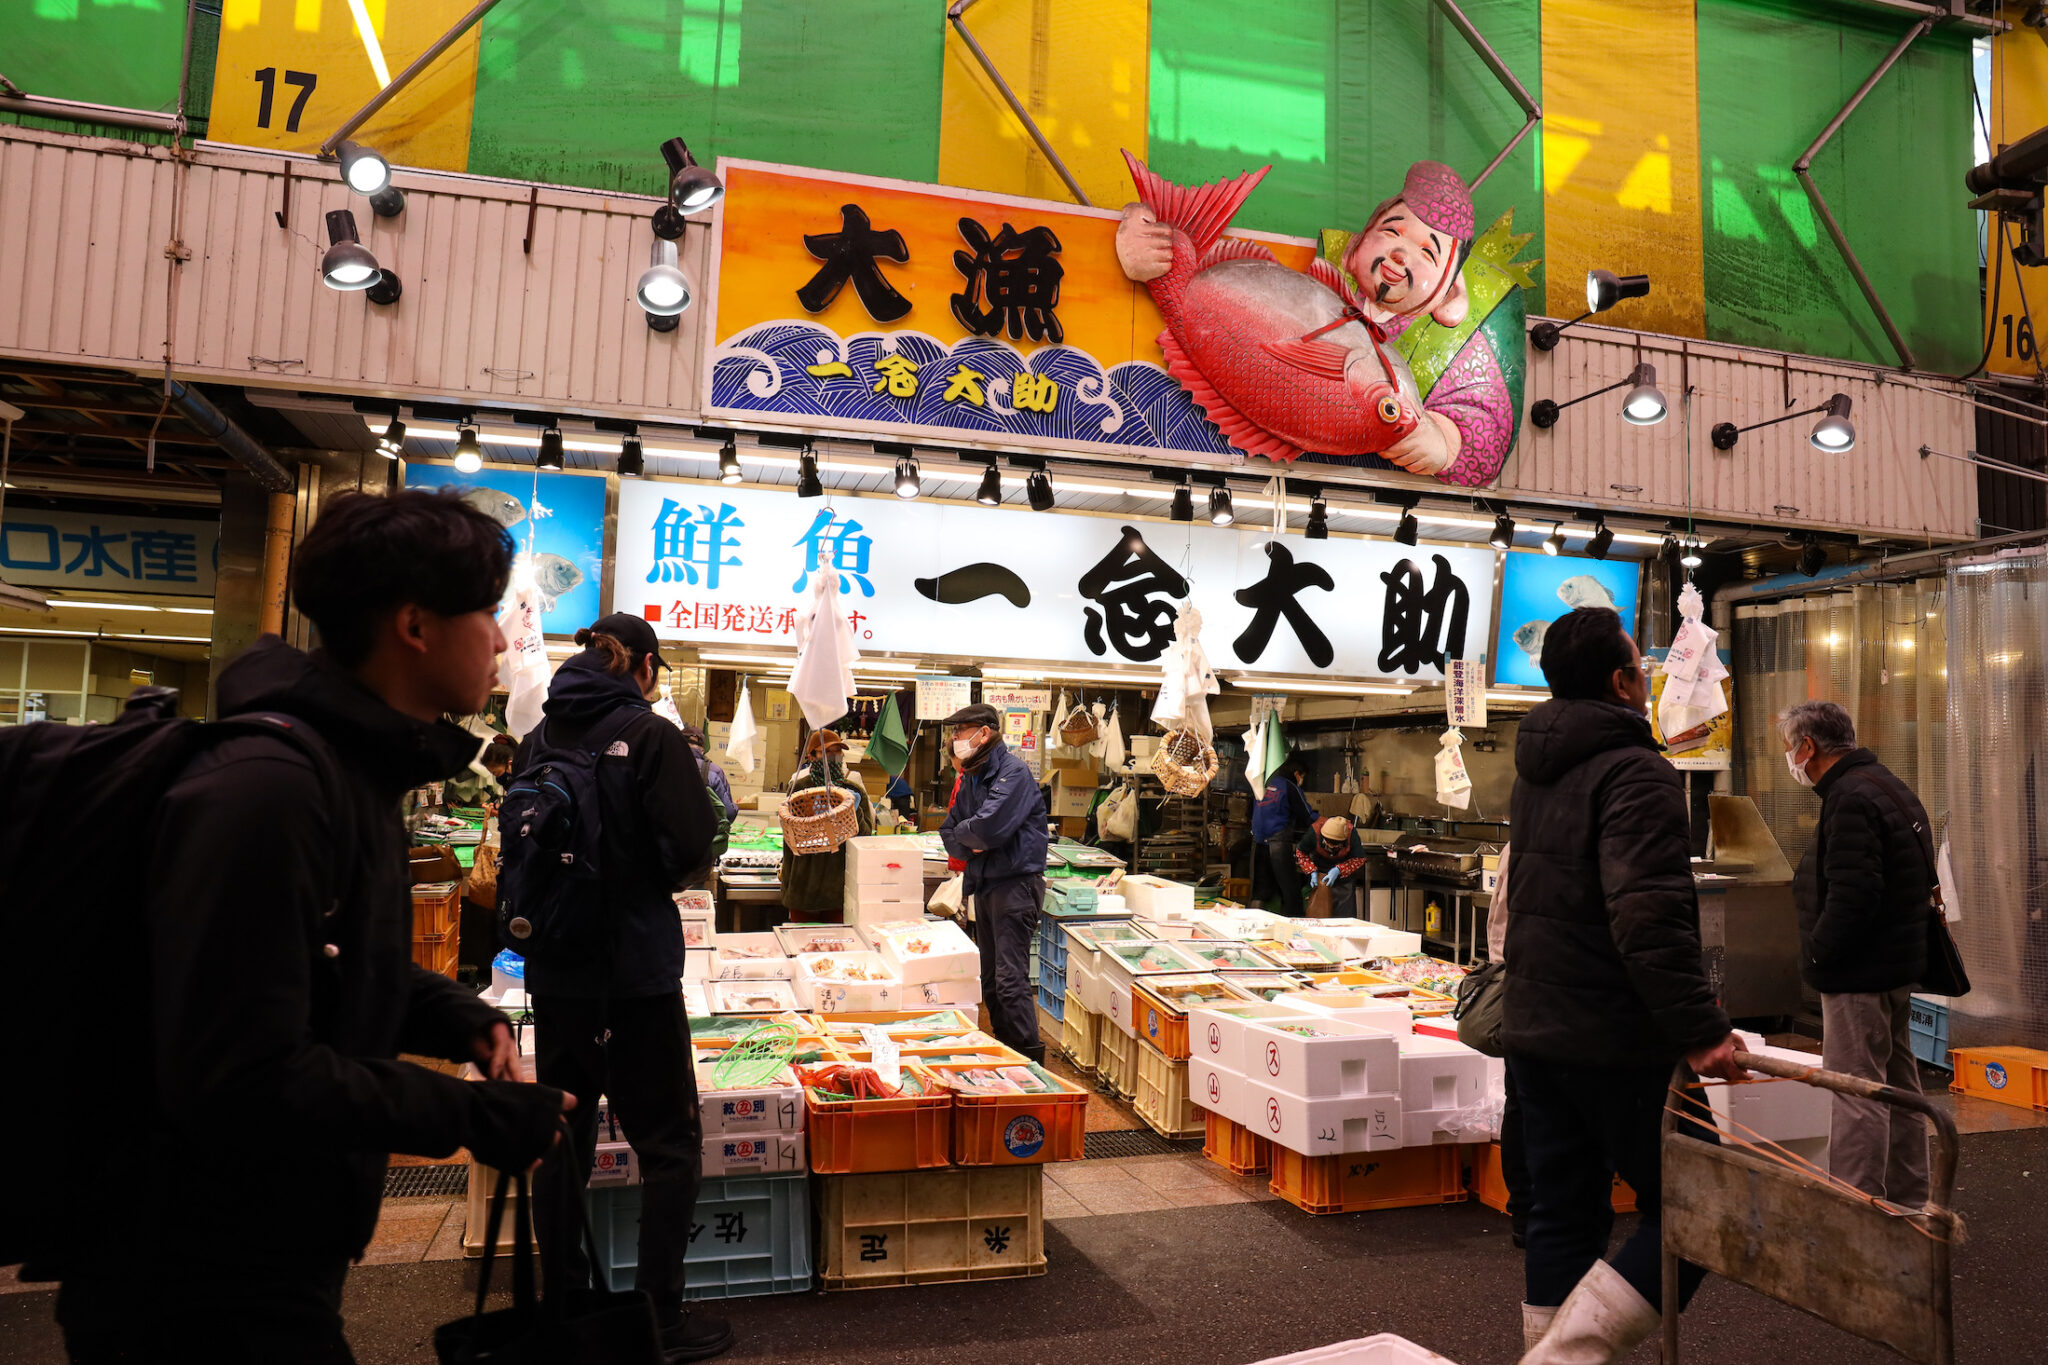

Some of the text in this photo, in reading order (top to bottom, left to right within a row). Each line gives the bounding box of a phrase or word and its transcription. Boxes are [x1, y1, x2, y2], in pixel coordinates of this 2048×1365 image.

[254, 66, 318, 133] 17
[796, 203, 1065, 343] 大漁
[2002, 314, 2034, 361] 16
[645, 497, 876, 598] 鮮魚
[666, 600, 873, 639] 全国発送承す。
[1453, 661, 1466, 723] 能登海洋深層水
[777, 1098, 797, 1129] 14
[776, 1138, 796, 1169] 14
[860, 1225, 1011, 1262] 糸 定
